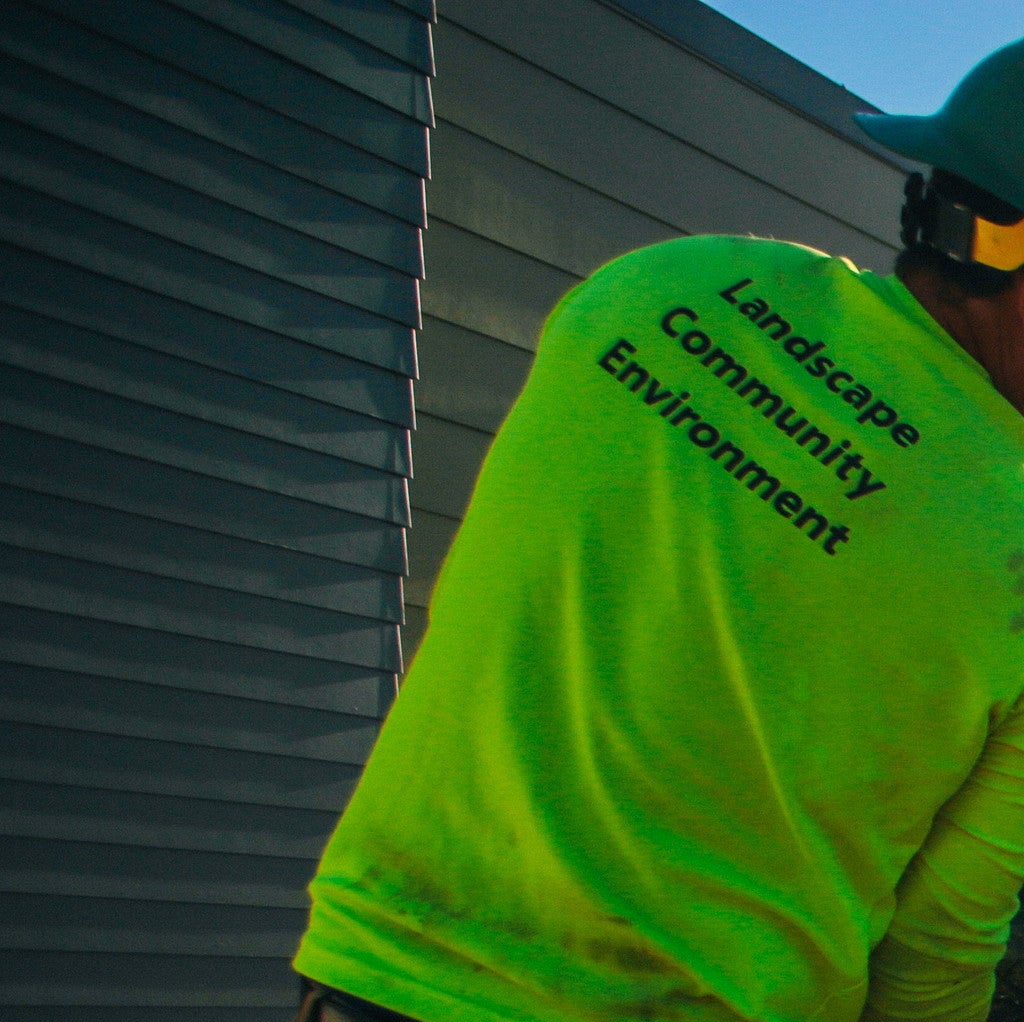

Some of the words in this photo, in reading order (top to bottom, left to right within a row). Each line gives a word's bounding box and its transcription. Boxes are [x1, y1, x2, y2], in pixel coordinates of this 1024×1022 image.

[597, 338, 851, 556] Environment
[660, 306, 887, 500] Community
[718, 277, 920, 449] Landscape
